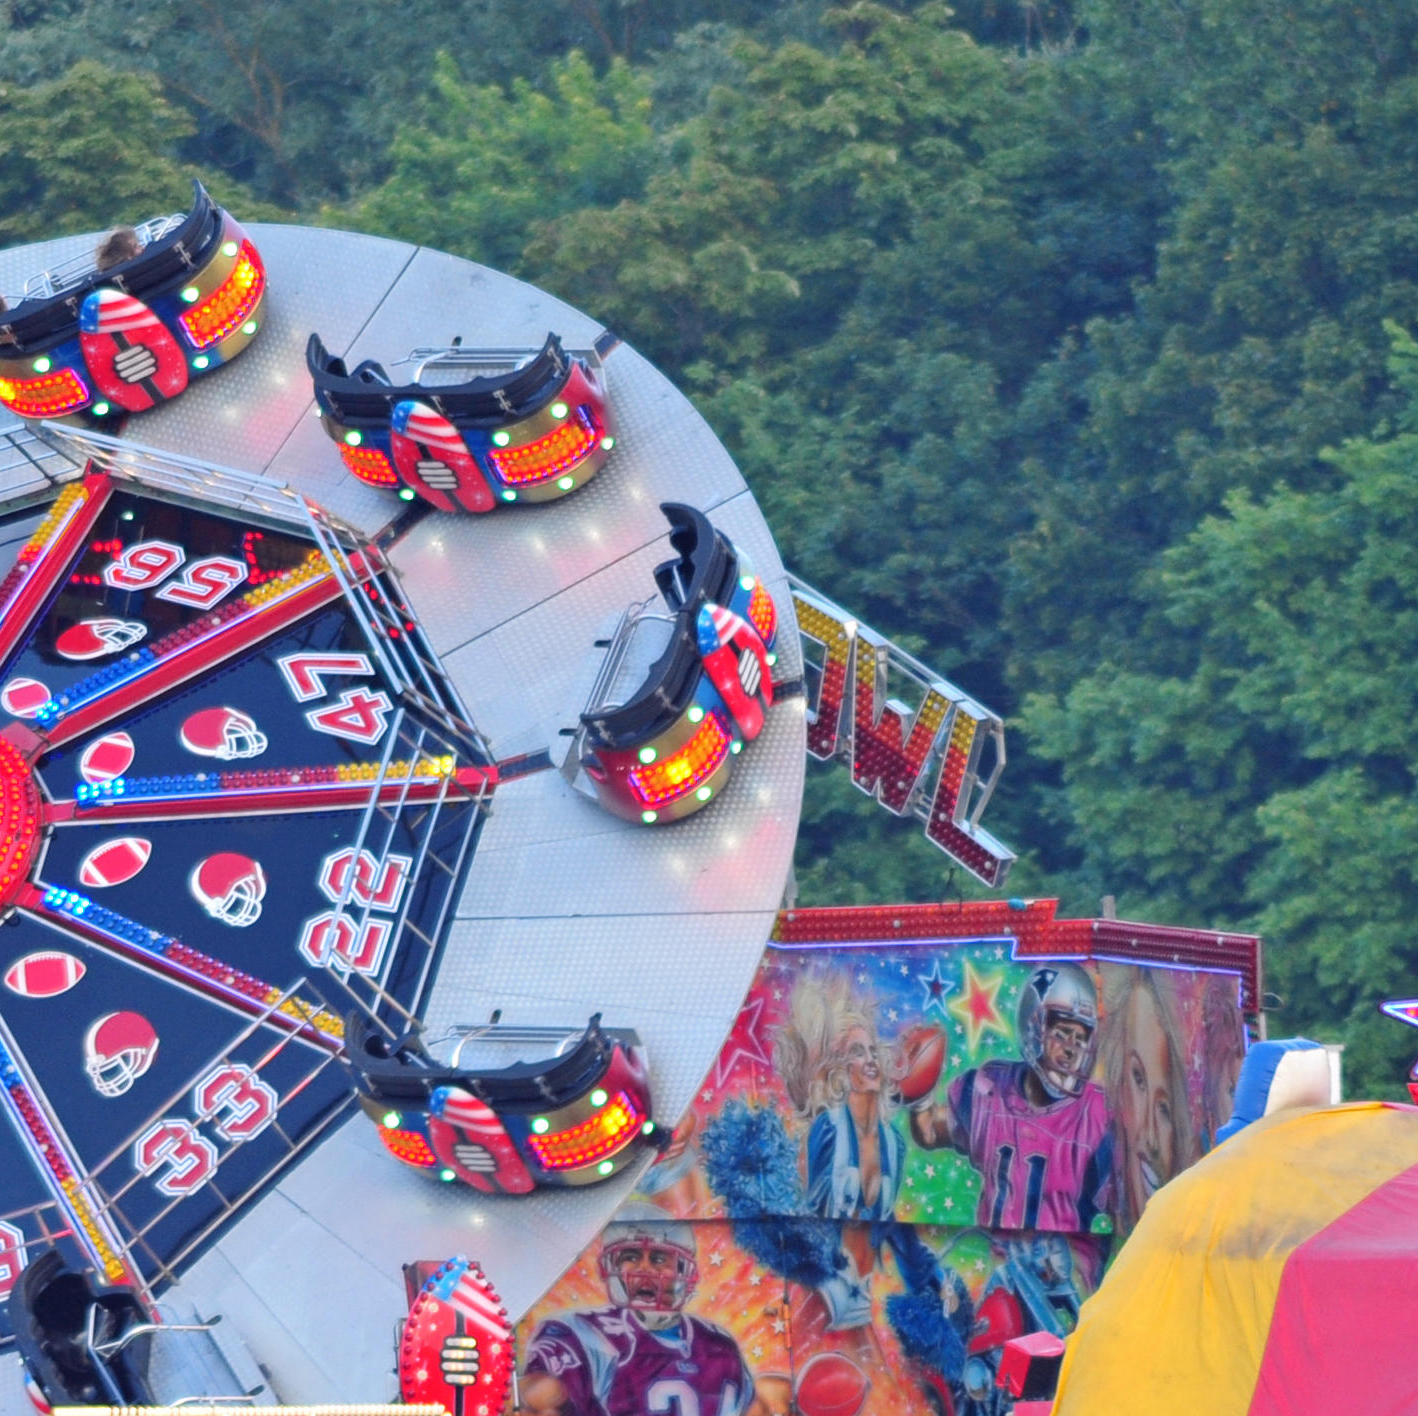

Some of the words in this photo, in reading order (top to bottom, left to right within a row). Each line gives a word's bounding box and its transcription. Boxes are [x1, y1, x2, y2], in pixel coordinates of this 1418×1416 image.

[277, 652, 394, 745] 47
[298, 846, 413, 977] 22
[134, 1062, 279, 1197] 33
